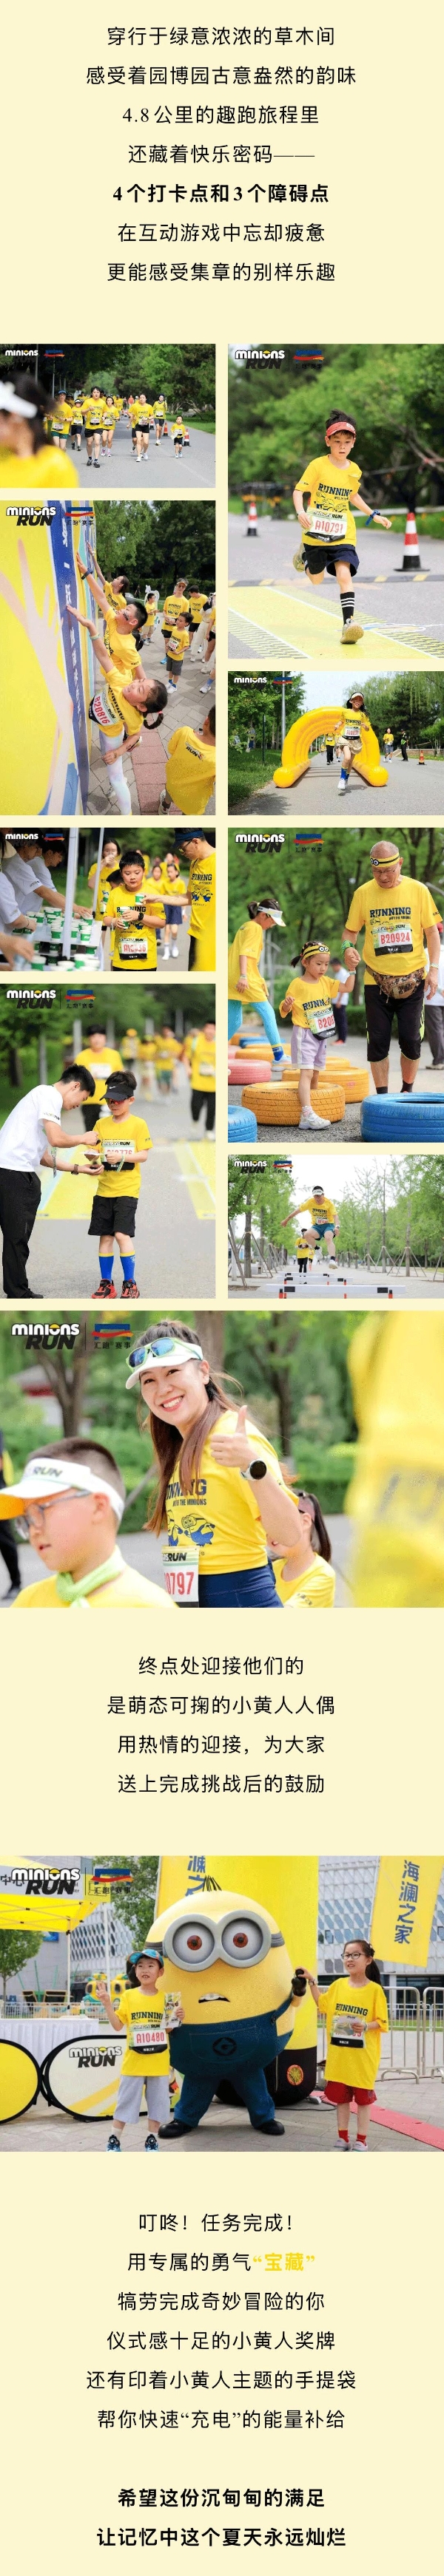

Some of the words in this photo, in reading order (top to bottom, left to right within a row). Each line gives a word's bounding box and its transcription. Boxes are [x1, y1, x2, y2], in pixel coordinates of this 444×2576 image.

[314, 520, 343, 534] A10791
[94, 696, 110, 724] B20816
[370, 907, 411, 918] RUNNING
[380, 933, 411, 944] B20924
[32, 1467, 62, 1477] RUN
[394, 1860, 420, 1945] 海澜之家
[335, 2003, 369, 2016] RUNNING
[136, 2032, 164, 2044] A10480
[69, 2046, 123, 2058] minions
[78, 2056, 115, 2068] RUN
